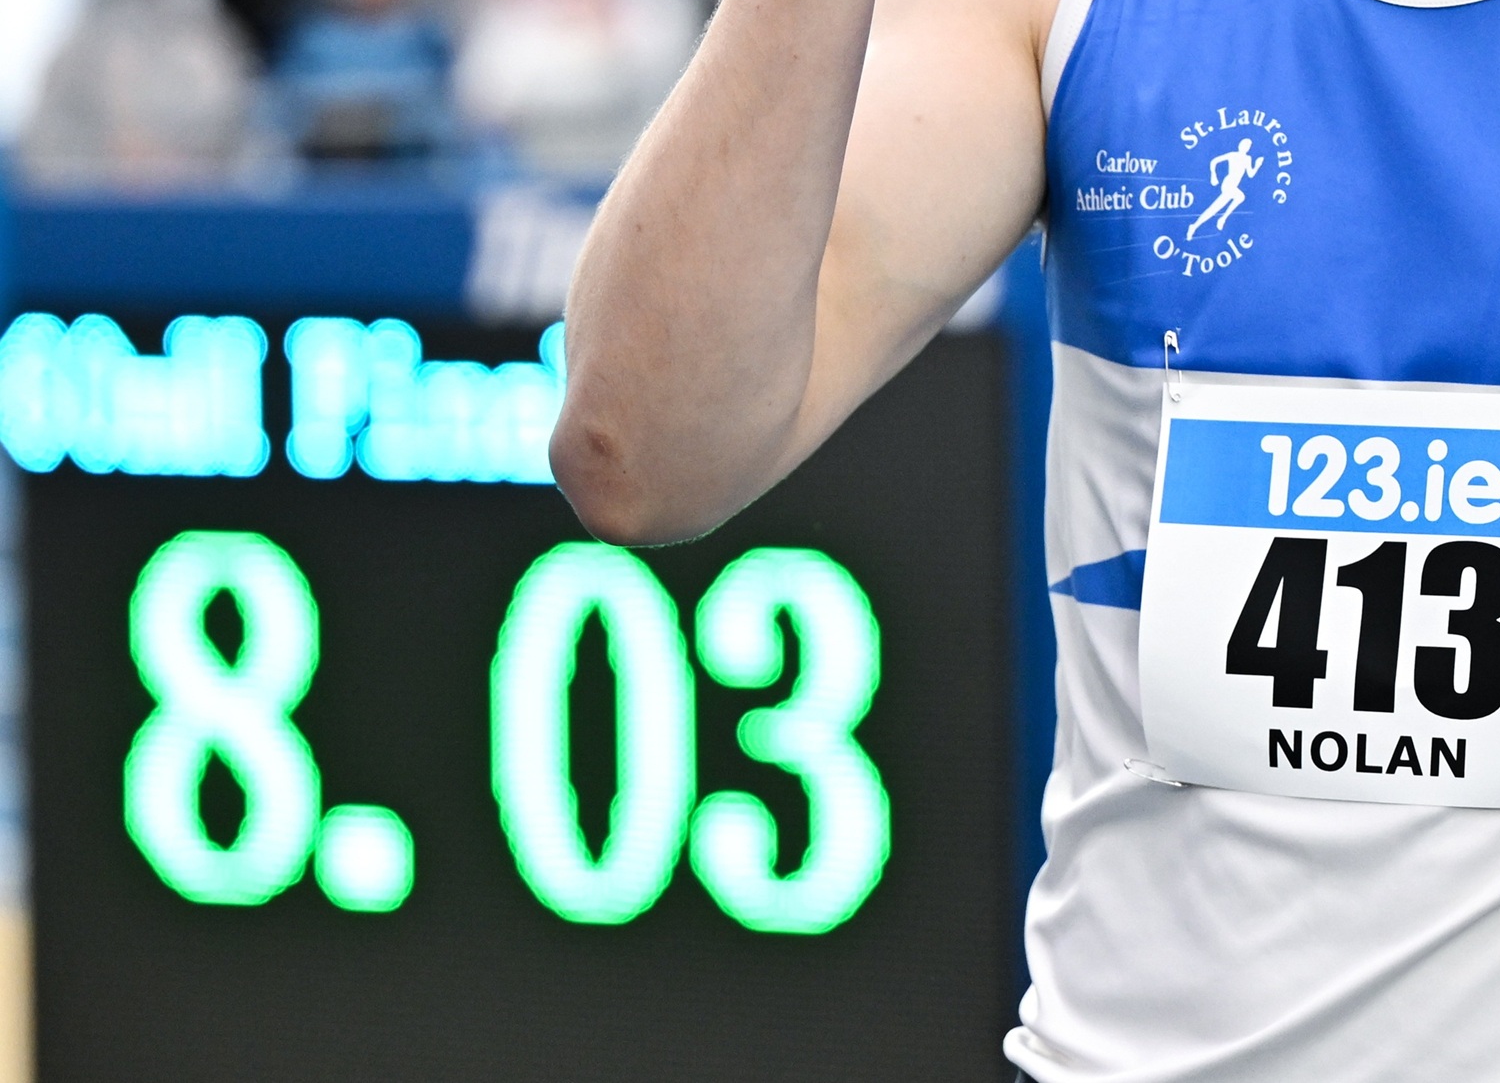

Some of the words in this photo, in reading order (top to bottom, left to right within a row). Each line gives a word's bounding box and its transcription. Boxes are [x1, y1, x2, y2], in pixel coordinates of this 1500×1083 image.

[1096, 149, 1158, 174] Carlow
[1180, 120, 1214, 150] St.
[1217, 107, 1293, 204] Laurence
[1076, 186, 1133, 211] Athletic
[1140, 184, 1194, 210] Club
[1153, 232, 1254, 277] O'Toole
[1269, 729, 1467, 779] NOLAN
